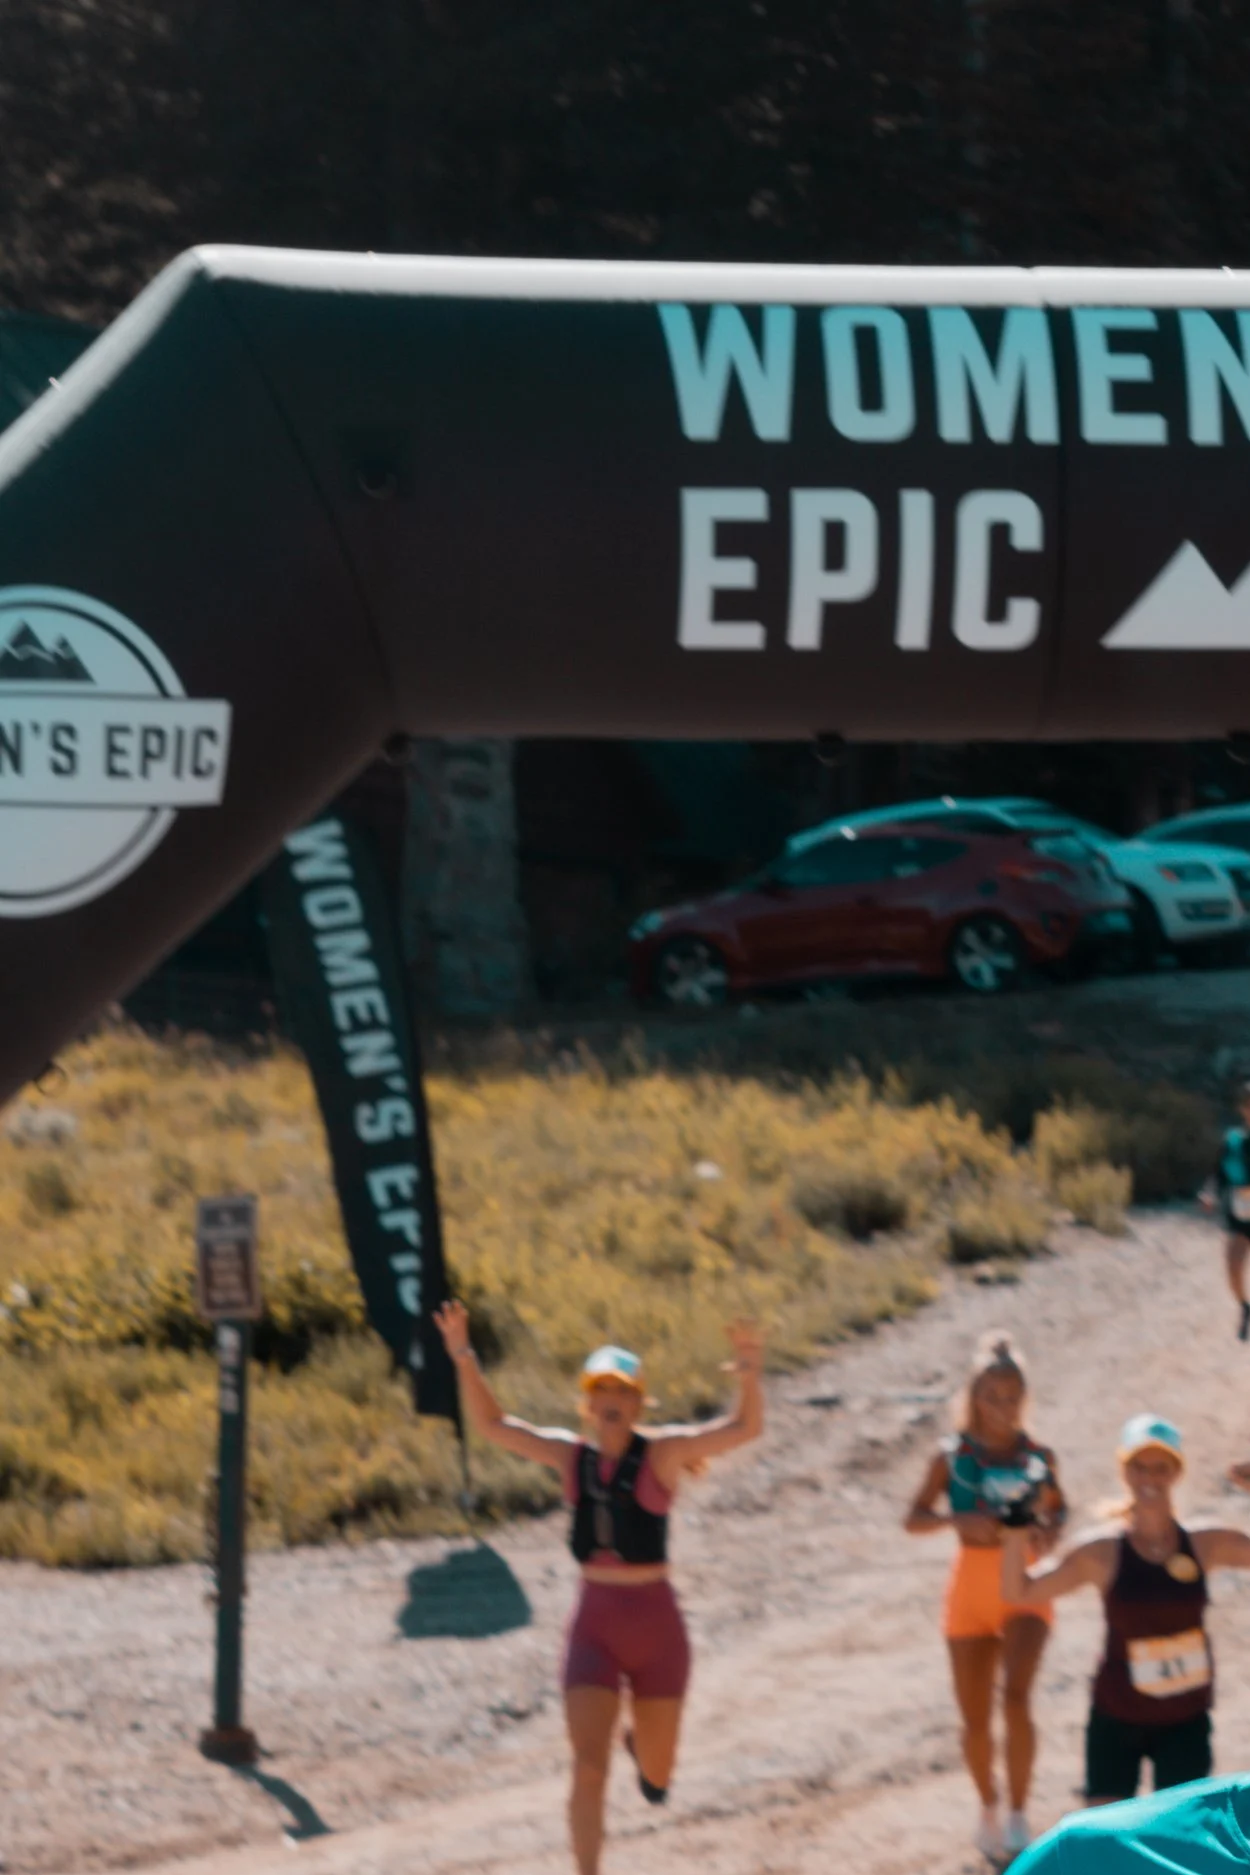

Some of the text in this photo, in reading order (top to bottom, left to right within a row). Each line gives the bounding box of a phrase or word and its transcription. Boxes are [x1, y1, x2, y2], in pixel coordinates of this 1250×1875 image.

[676, 487, 1045, 652] EPIC
[103, 723, 219, 780] EPIC
[283, 818, 416, 1143] WOMEN'S
